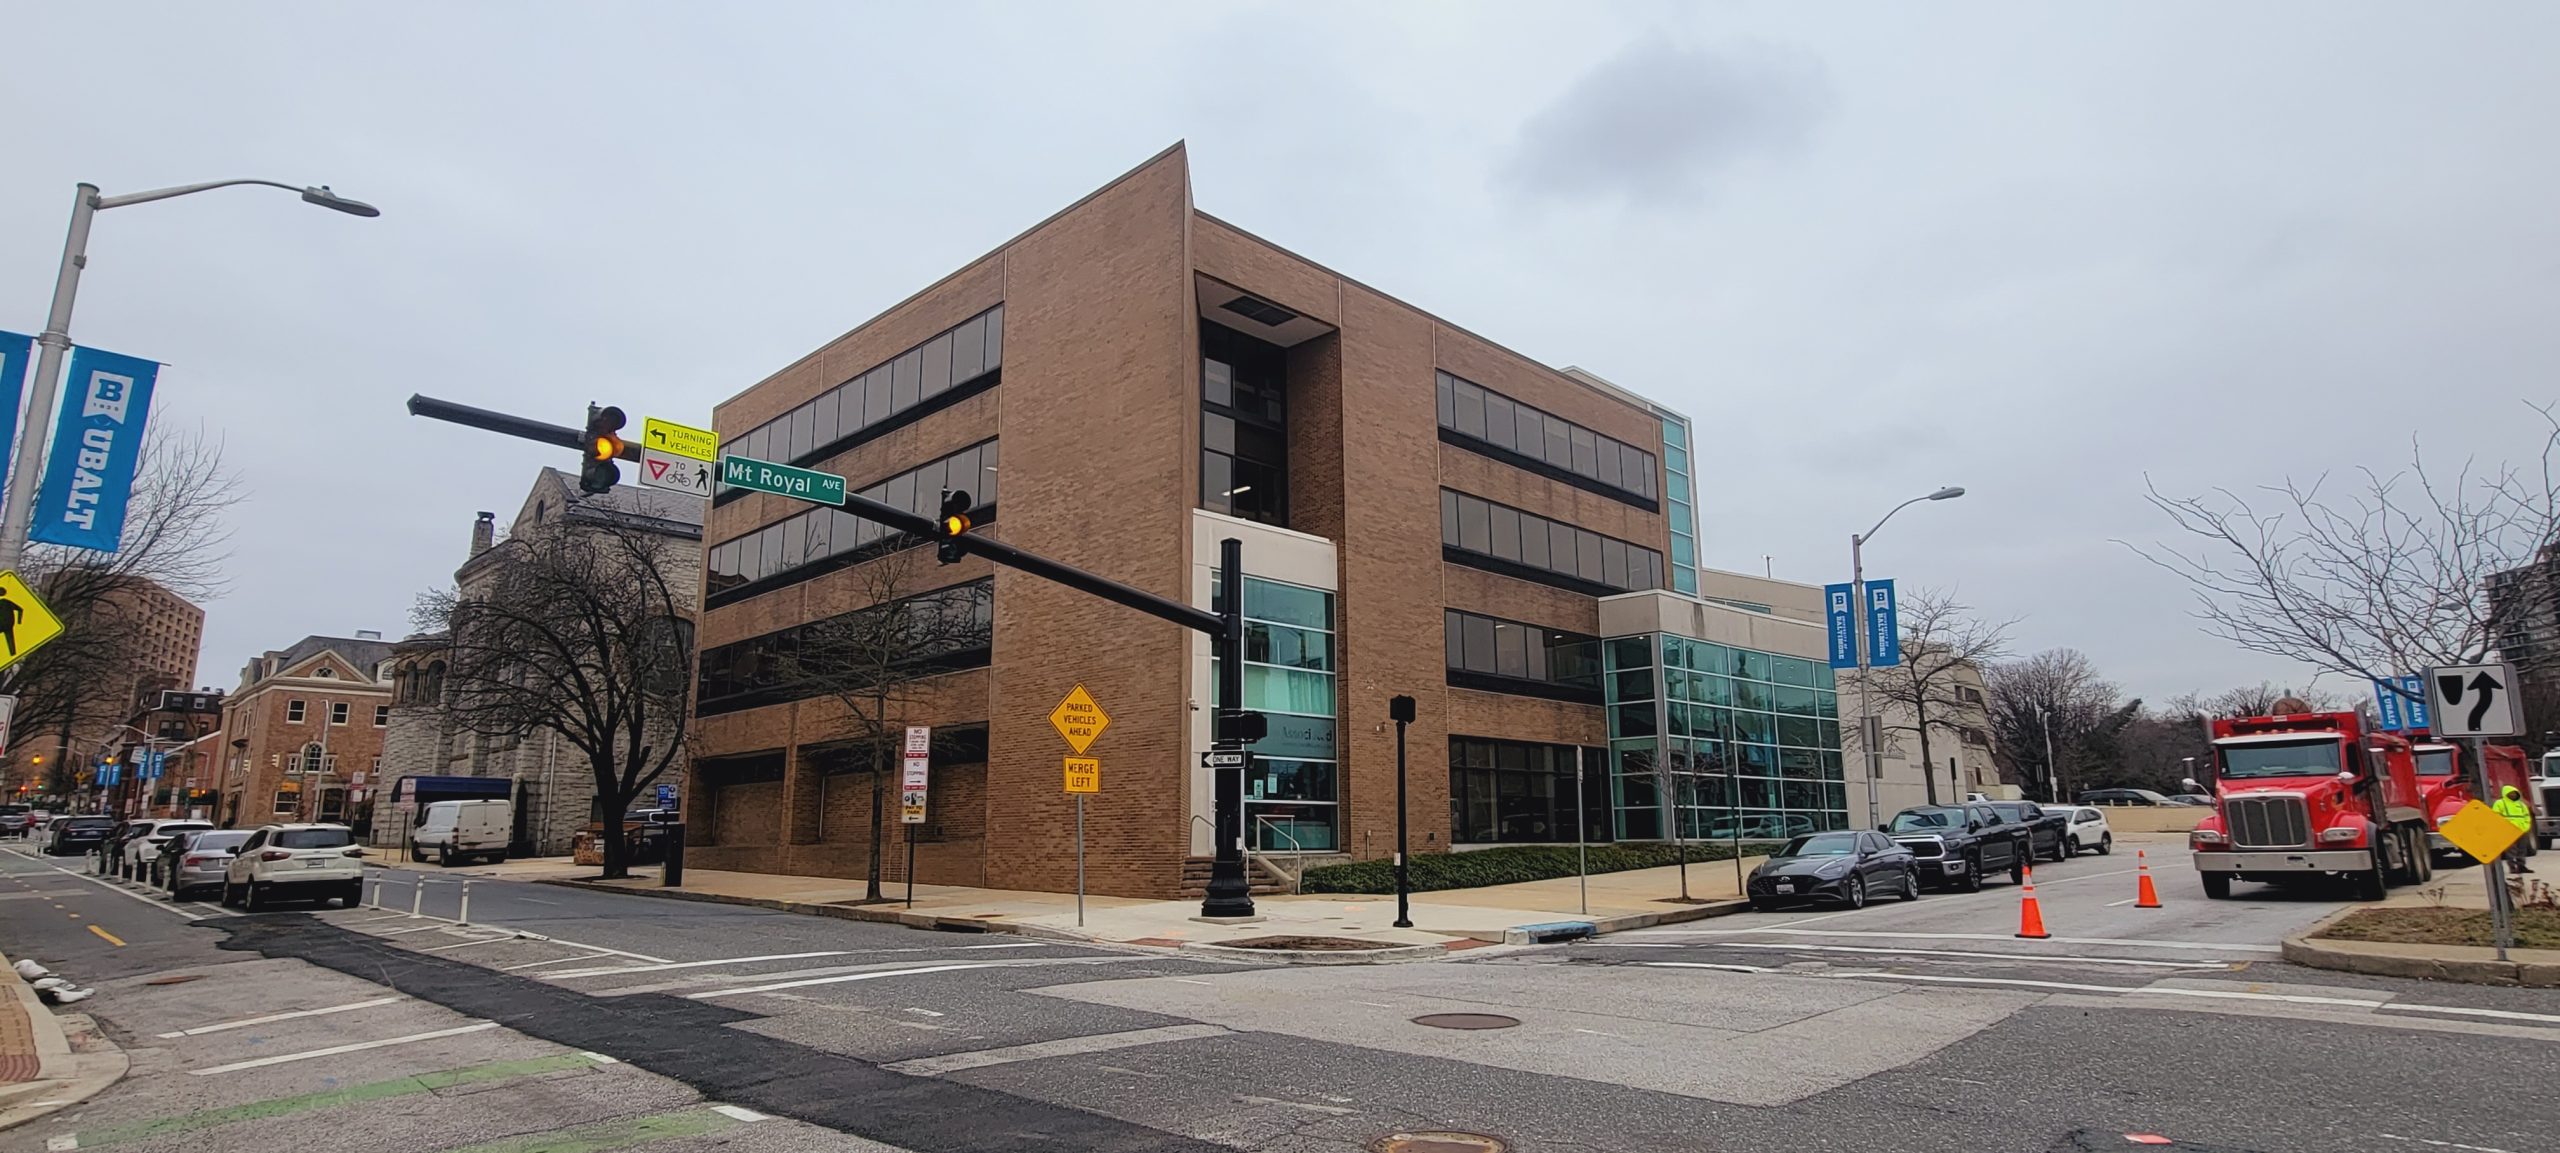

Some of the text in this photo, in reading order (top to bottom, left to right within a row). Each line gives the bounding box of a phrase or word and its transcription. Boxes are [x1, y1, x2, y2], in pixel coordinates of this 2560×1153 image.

[95, 378, 123, 402] B
[672, 429, 712, 446] TURNING
[669, 441, 712, 458] VEHICLES
[675, 461, 686, 471] TO
[64, 428, 115, 531] UBALT
[728, 462, 841, 493] Mt Royal AVE
[1835, 595, 1844, 604] B
[1876, 592, 1885, 601] B
[1836, 616, 1845, 660] BALTIMORE
[1877, 613, 1886, 657] BALTIMORE
[1066, 703, 1093, 713] PARKED
[1063, 715, 1097, 725] VEHICLES
[1069, 727, 1092, 737] AHEAD
[1213, 755, 1240, 763] ONE WAY
[1068, 763, 1095, 774] MERGE
[1071, 777, 1091, 788] LEFT
